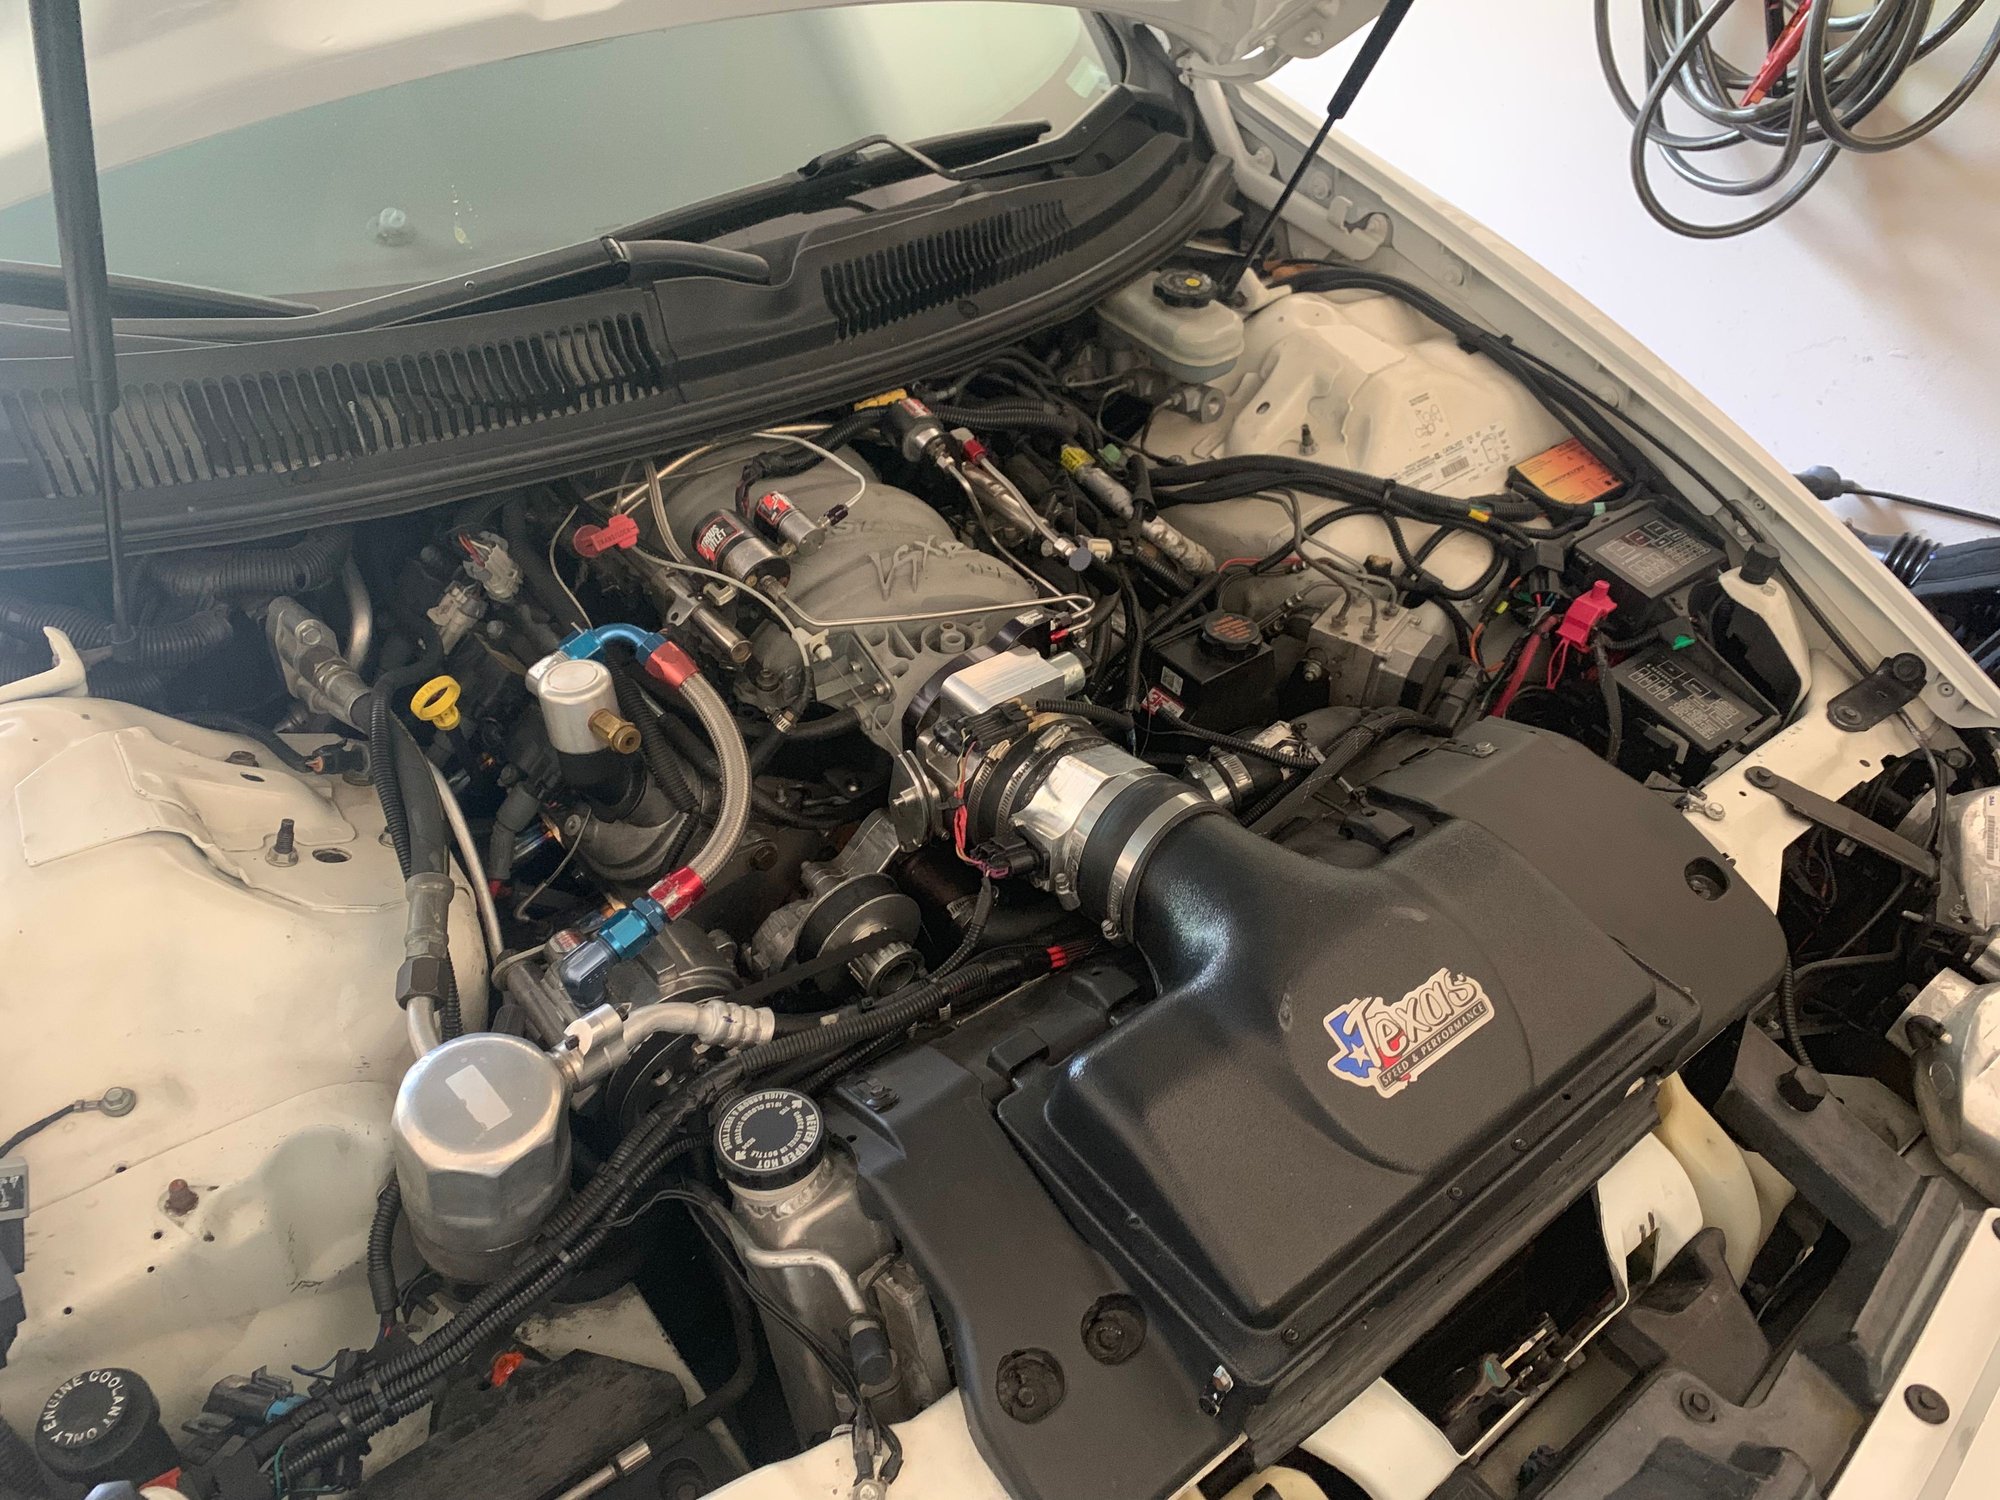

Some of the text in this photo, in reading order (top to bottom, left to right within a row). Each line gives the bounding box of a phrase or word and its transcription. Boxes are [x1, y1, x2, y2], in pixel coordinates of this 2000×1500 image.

[1342, 970, 1477, 1069] Texas
[1381, 1002, 1485, 1086] SPEED & PERFORMANCE
[787, 1130, 803, 1148] LEVEL
[802, 1113, 817, 1143] NEVER
[750, 1150, 779, 1159] BOTTLE
[756, 1159, 779, 1169] HOT
[781, 1143, 808, 1165] OPEN
[42, 1370, 125, 1446] ENGINE COOLANT ONLY
